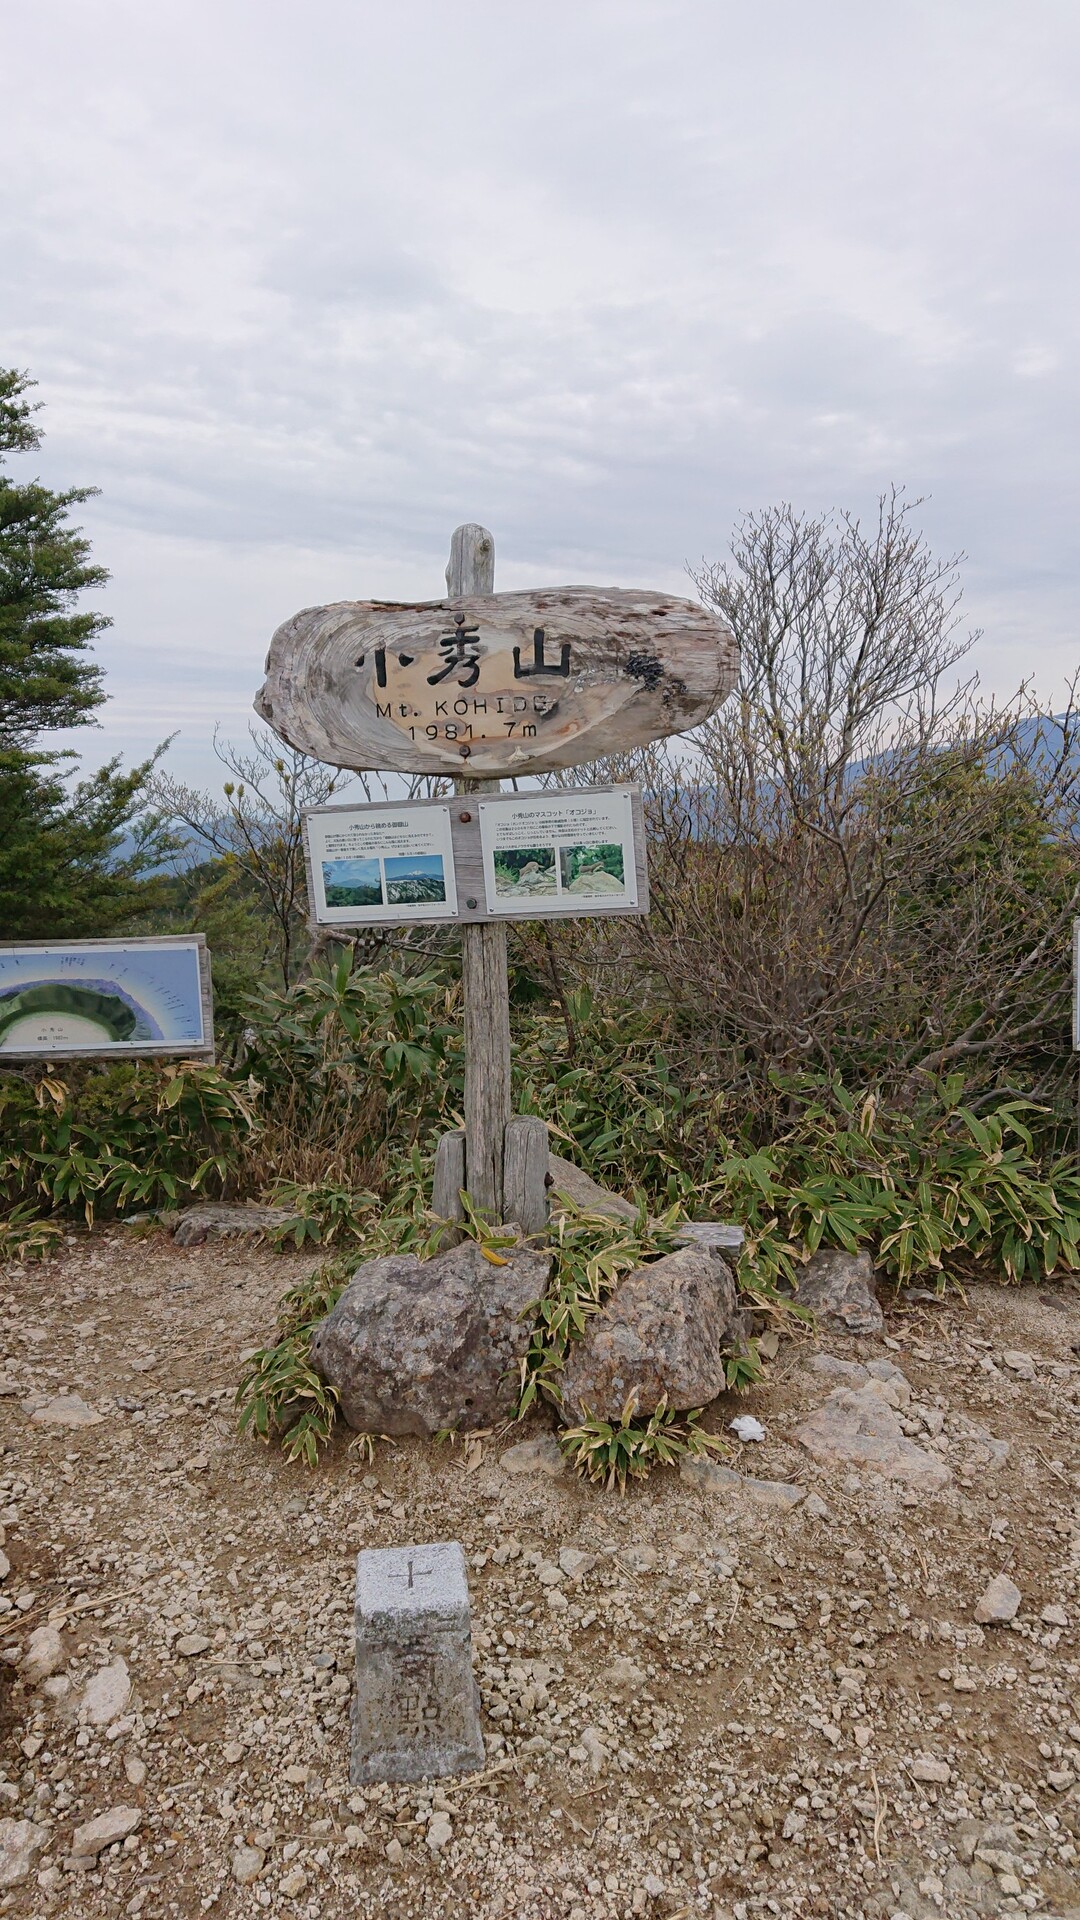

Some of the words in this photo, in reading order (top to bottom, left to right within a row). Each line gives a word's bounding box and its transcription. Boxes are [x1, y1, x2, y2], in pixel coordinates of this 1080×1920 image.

[355, 624, 572, 688] 小秀山
[376, 703, 420, 718] Mt.
[435, 695, 548, 716] KOHIDE
